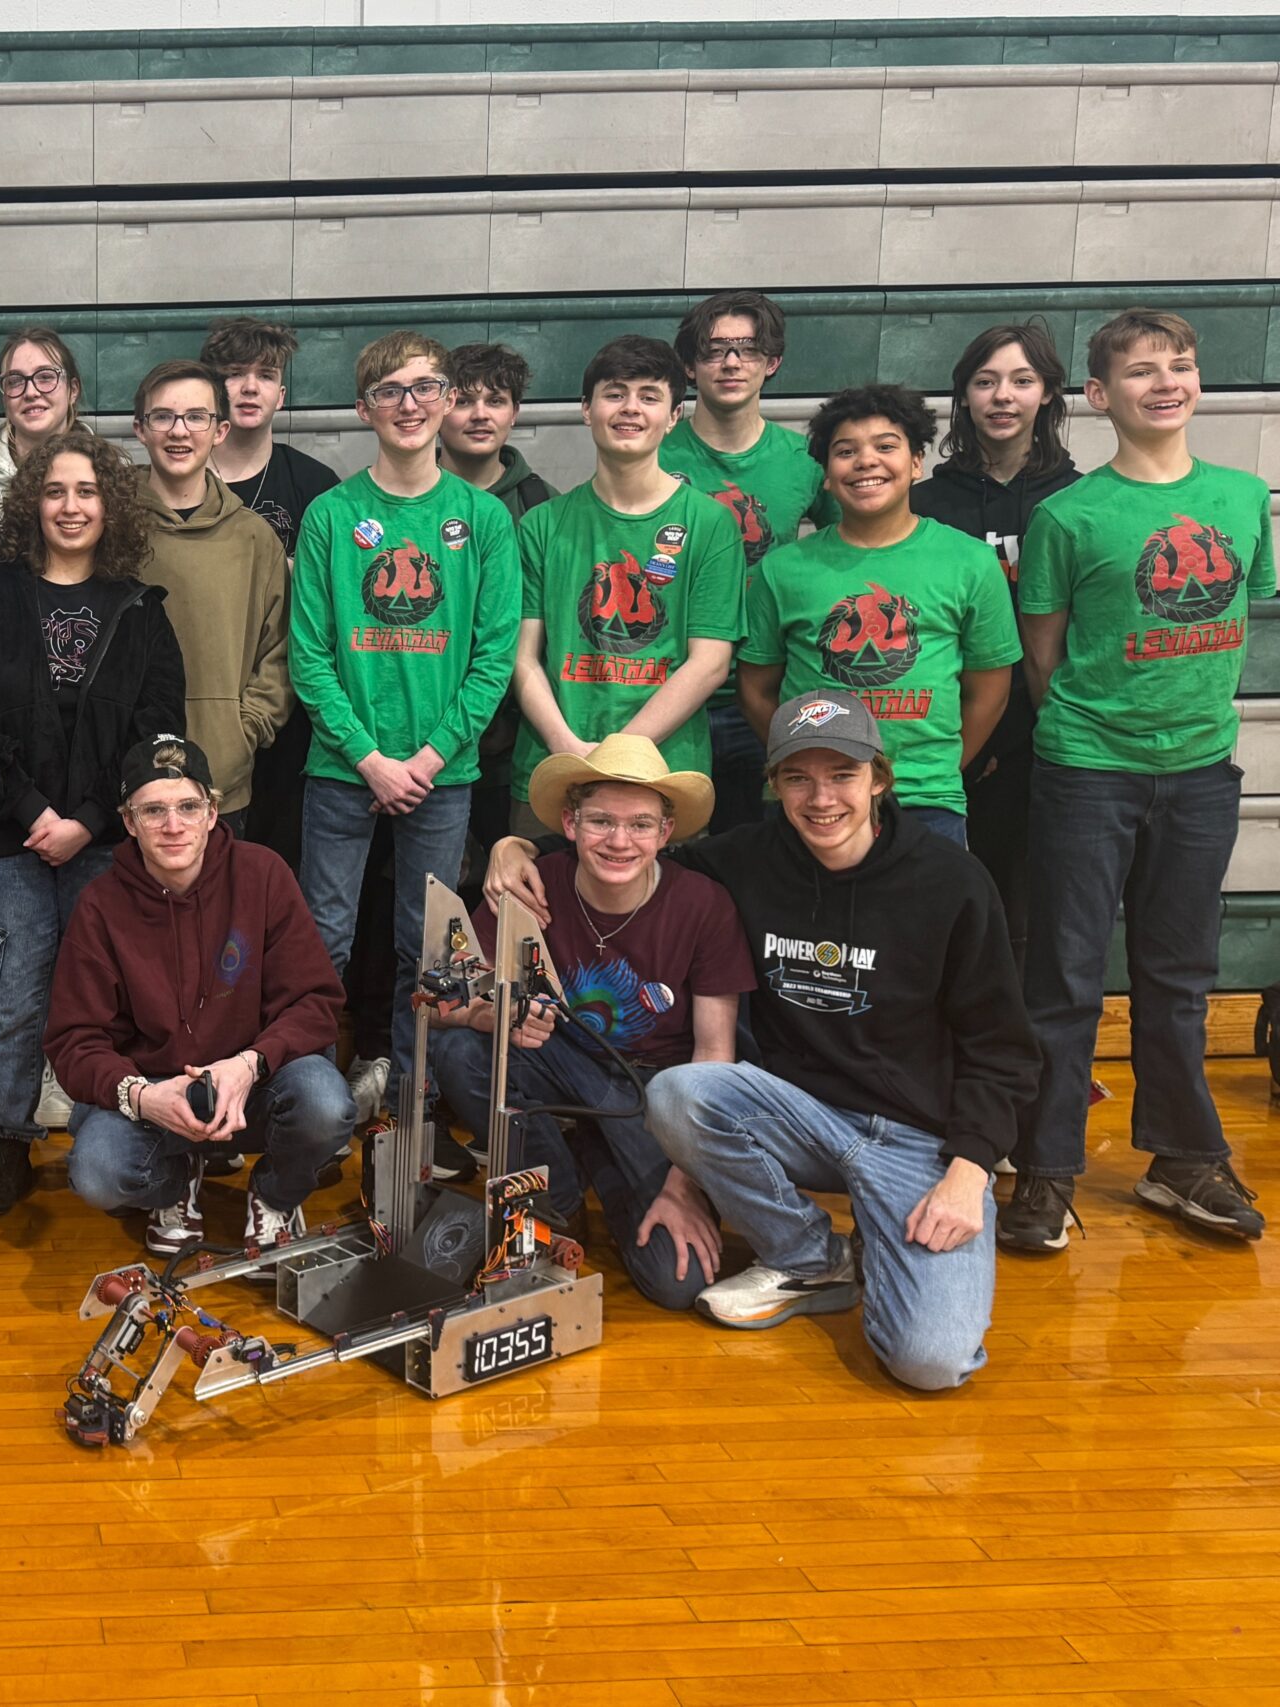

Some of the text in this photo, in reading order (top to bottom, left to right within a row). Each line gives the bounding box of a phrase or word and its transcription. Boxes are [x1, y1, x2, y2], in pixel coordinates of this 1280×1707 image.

[350, 627, 452, 654] LEVIATHAN
[561, 653, 673, 685] LEVIATHAN
[474, 1321, 546, 1374] 10355
